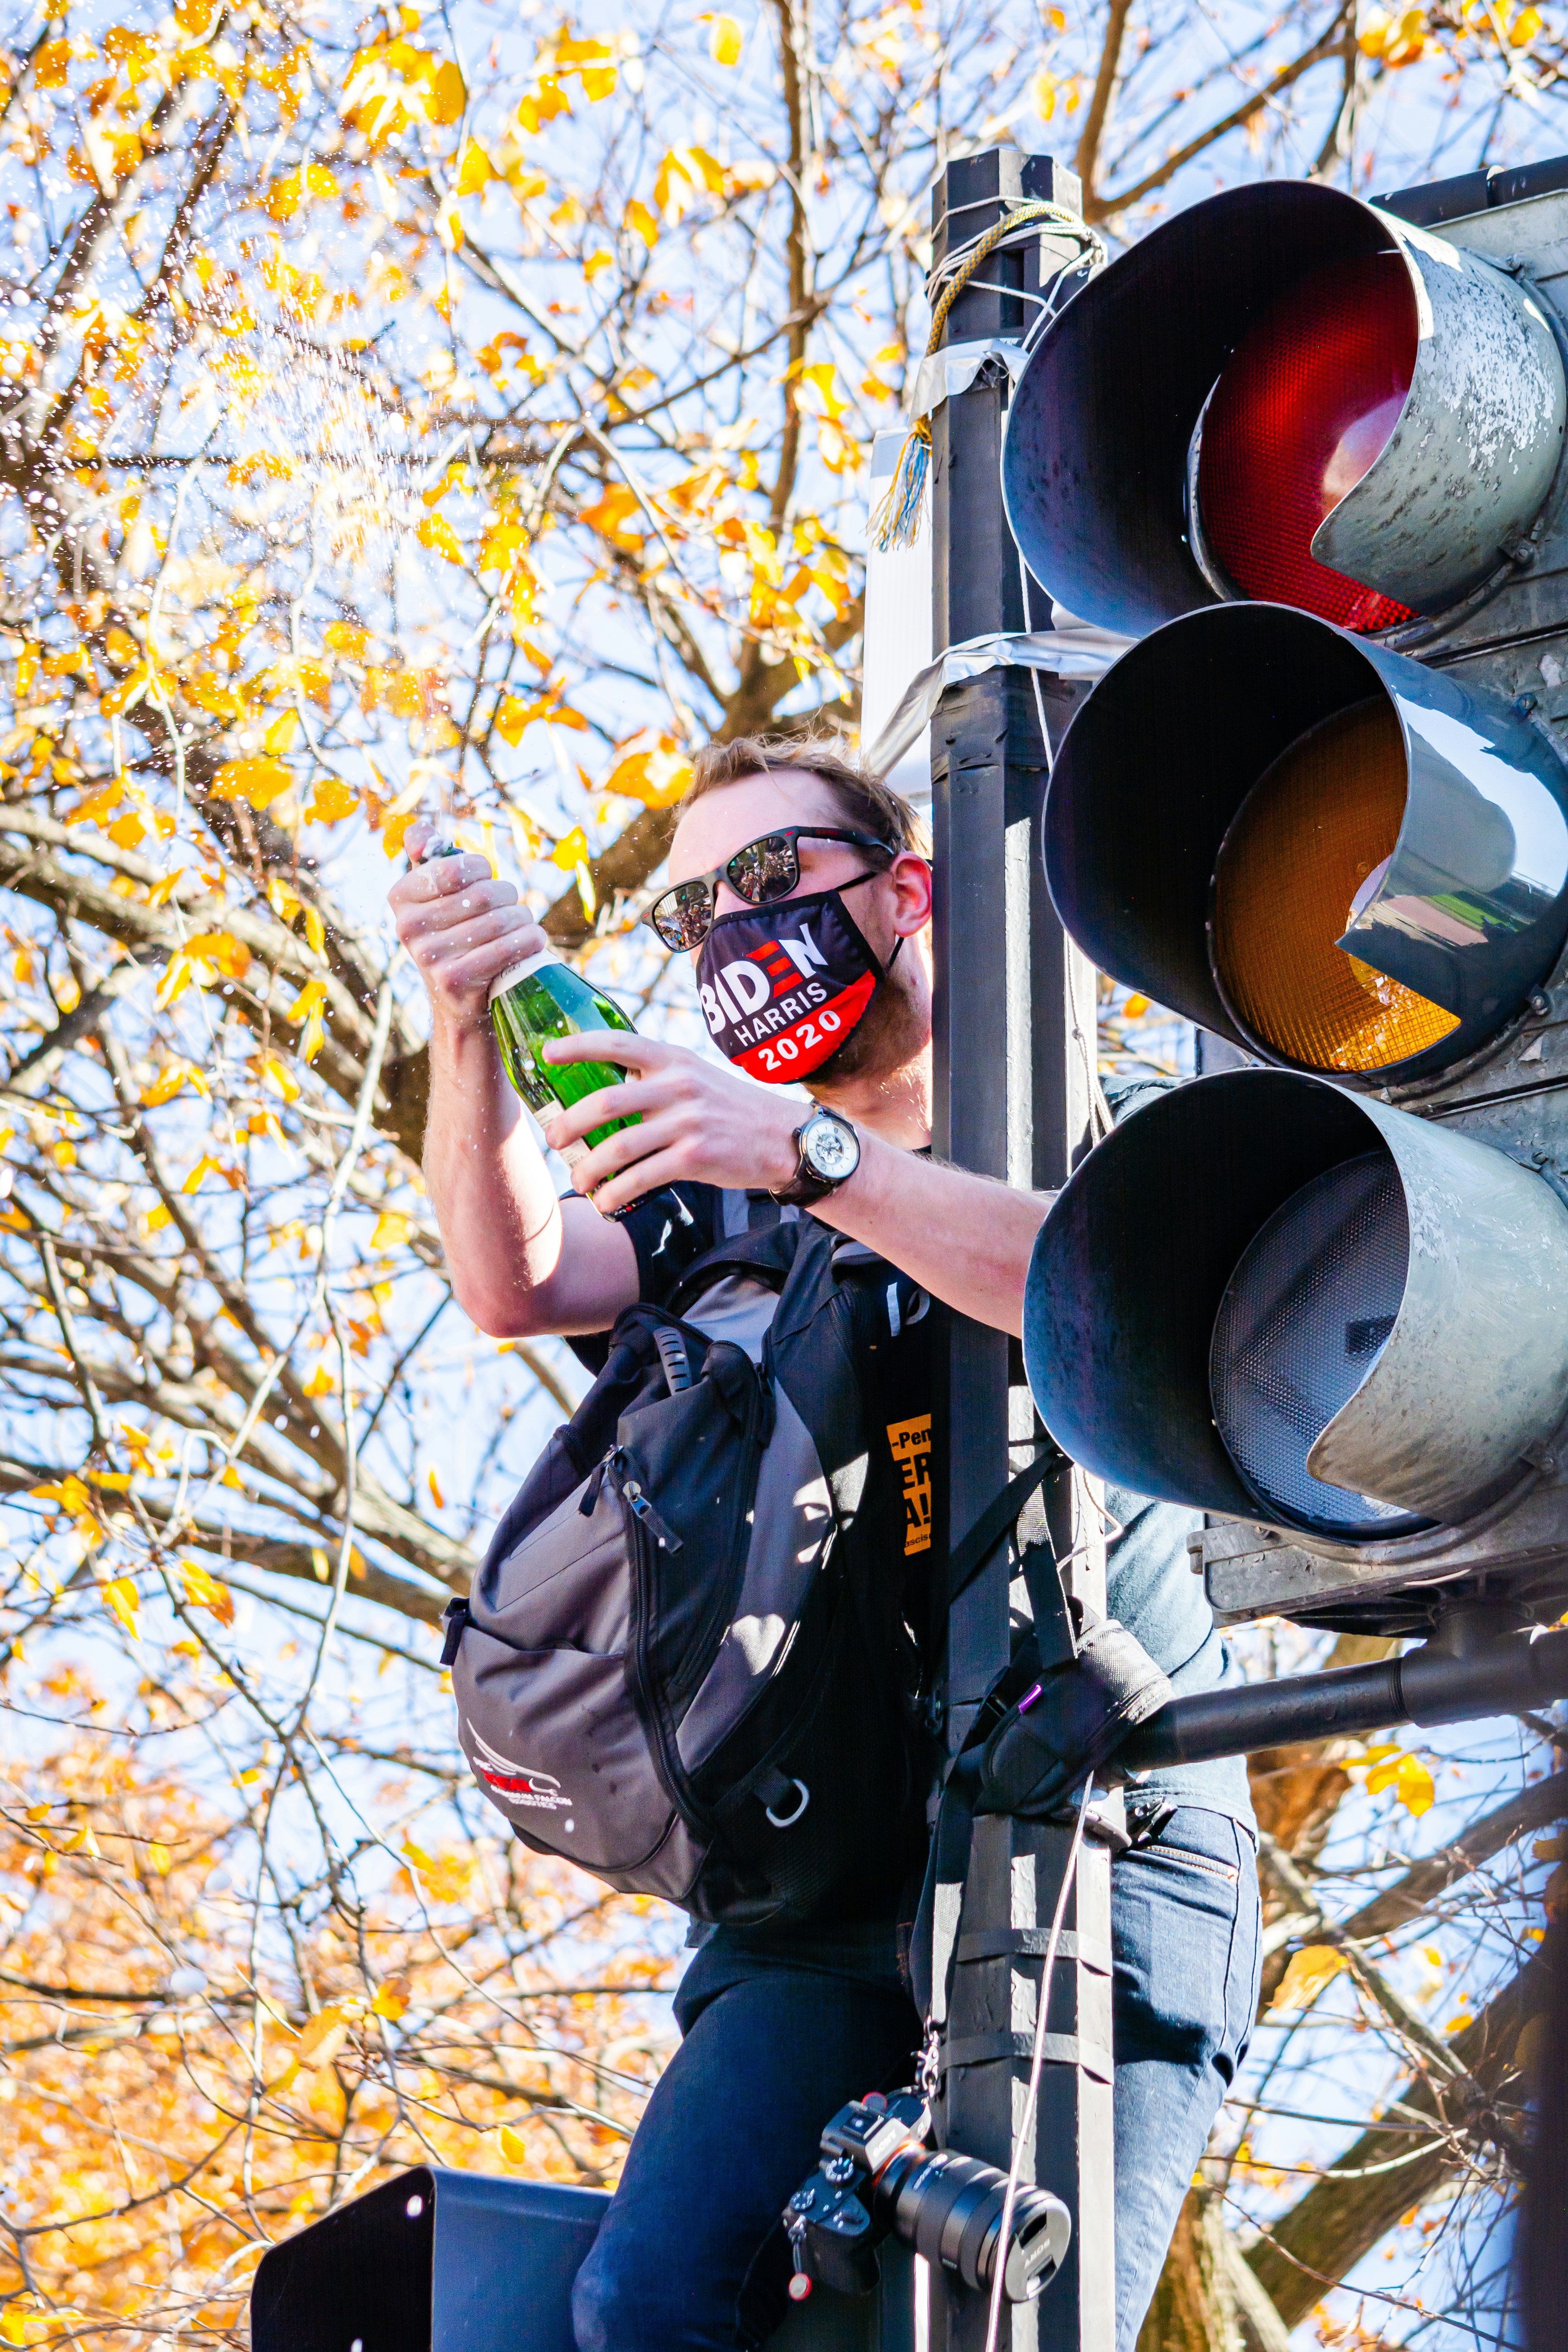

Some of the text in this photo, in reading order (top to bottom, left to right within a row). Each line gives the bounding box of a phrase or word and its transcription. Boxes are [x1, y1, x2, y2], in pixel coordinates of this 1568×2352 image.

[700, 923, 828, 1035] BIDEN
[734, 982, 827, 1047] HARRIS
[758, 1010, 841, 1071] 2020
[905, 1534, 931, 1547] ascis
